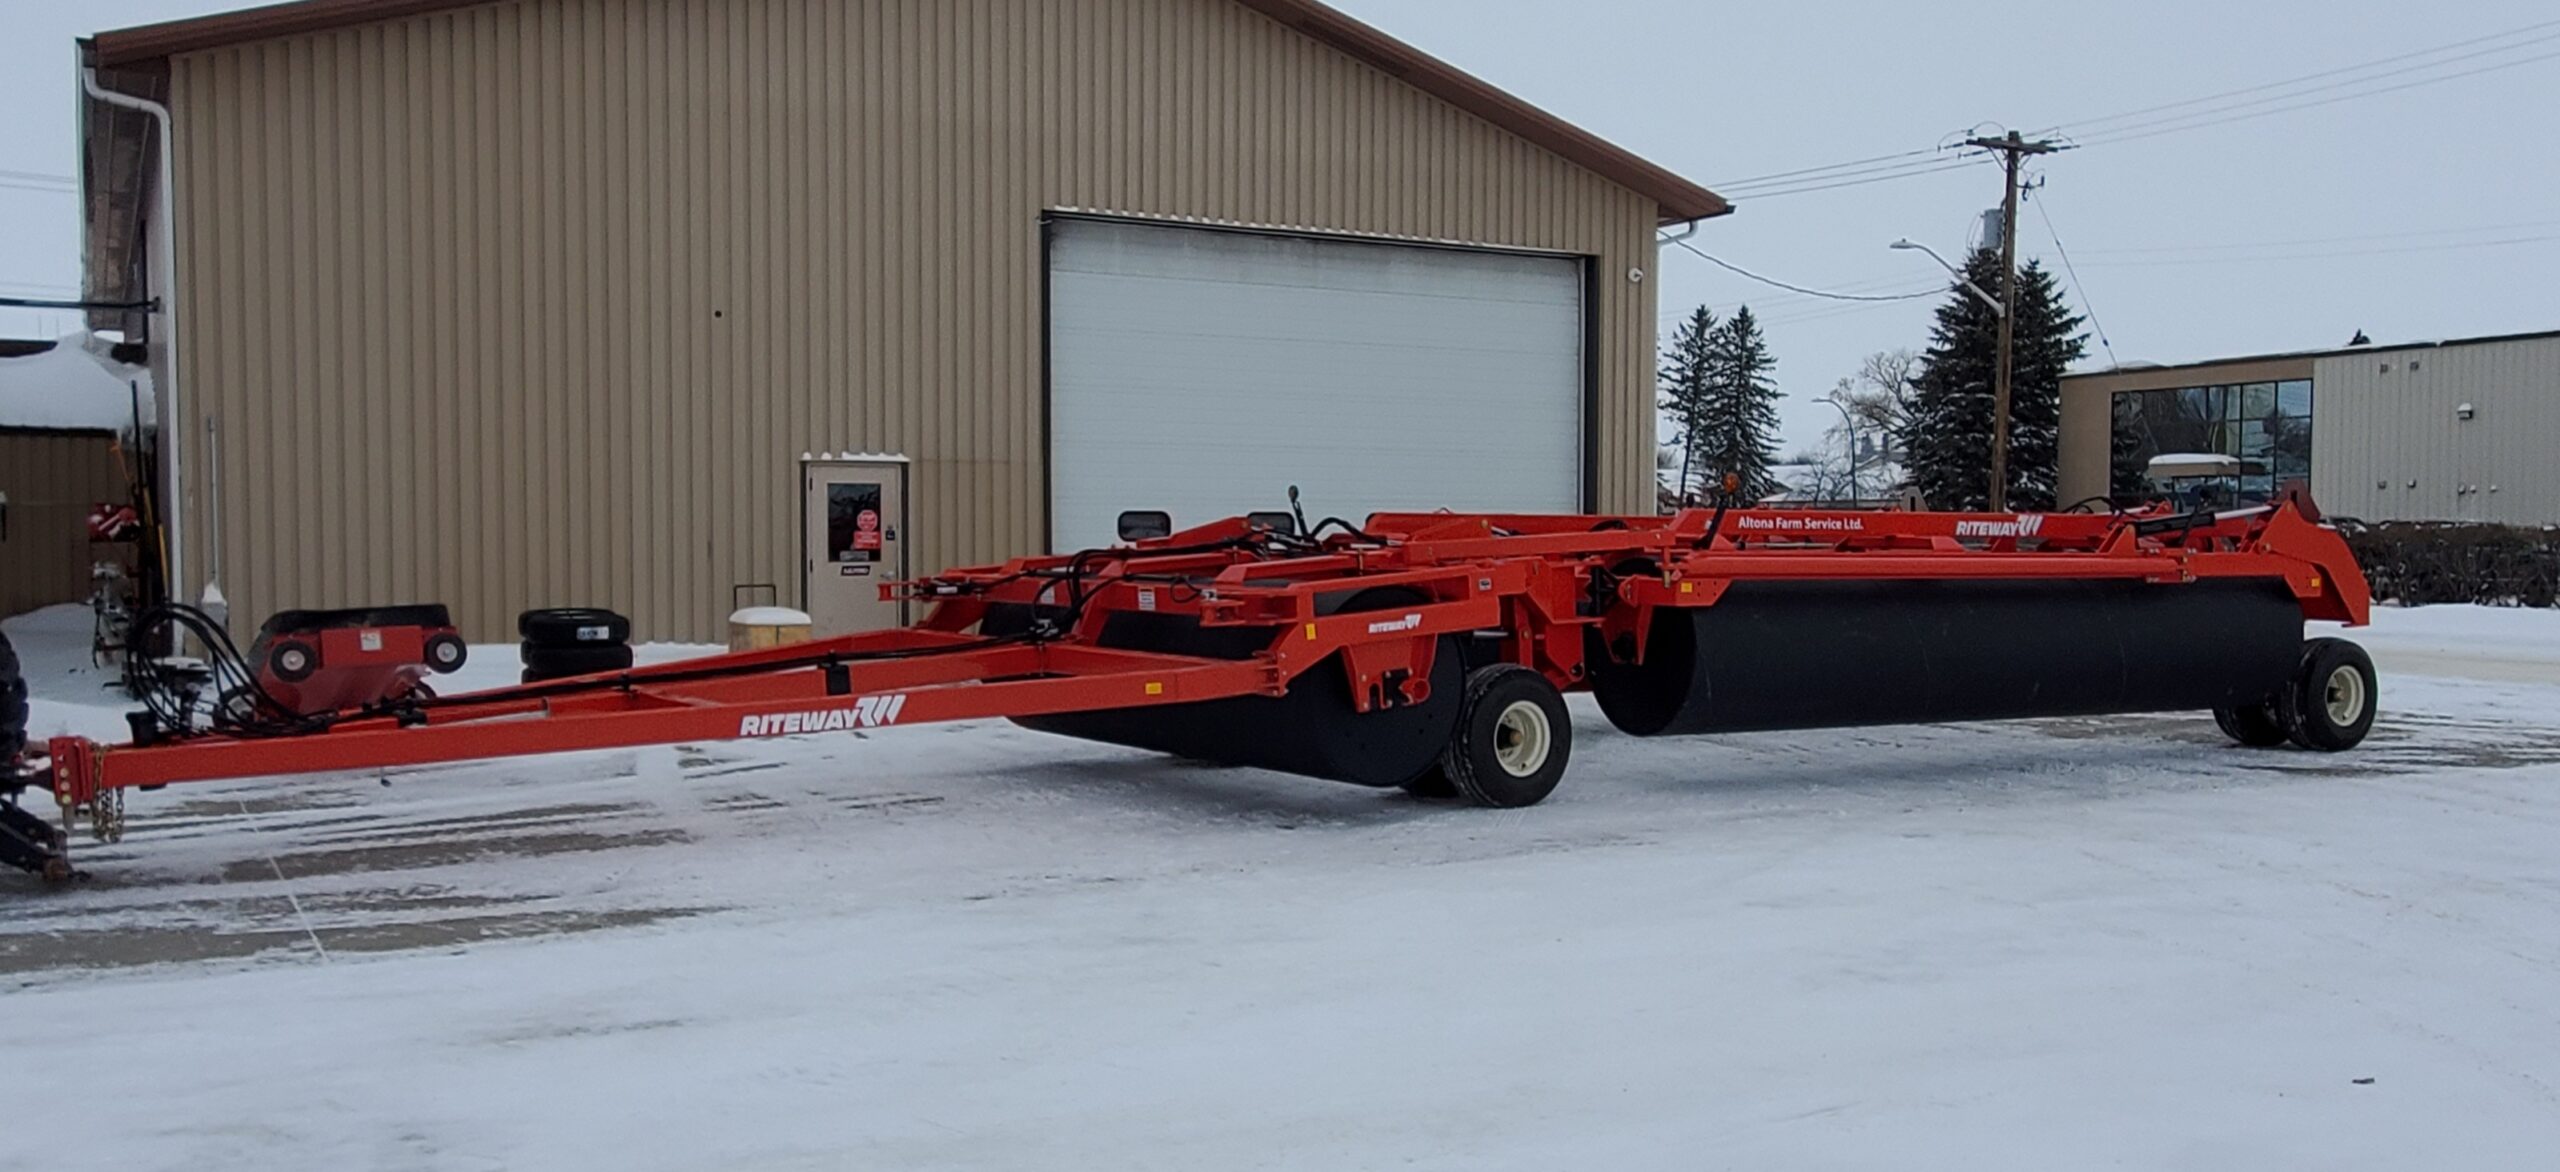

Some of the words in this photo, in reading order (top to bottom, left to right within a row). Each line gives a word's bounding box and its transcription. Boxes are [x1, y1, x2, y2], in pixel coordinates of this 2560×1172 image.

[1738, 515, 1774, 529] Altona
[1776, 516, 1803, 529] Farm
[1804, 516, 1842, 530] Service
[1844, 517, 1864, 530] Ltd.
[1955, 520, 2019, 537] RITEWAY
[740, 708, 860, 736] RITEWAY
